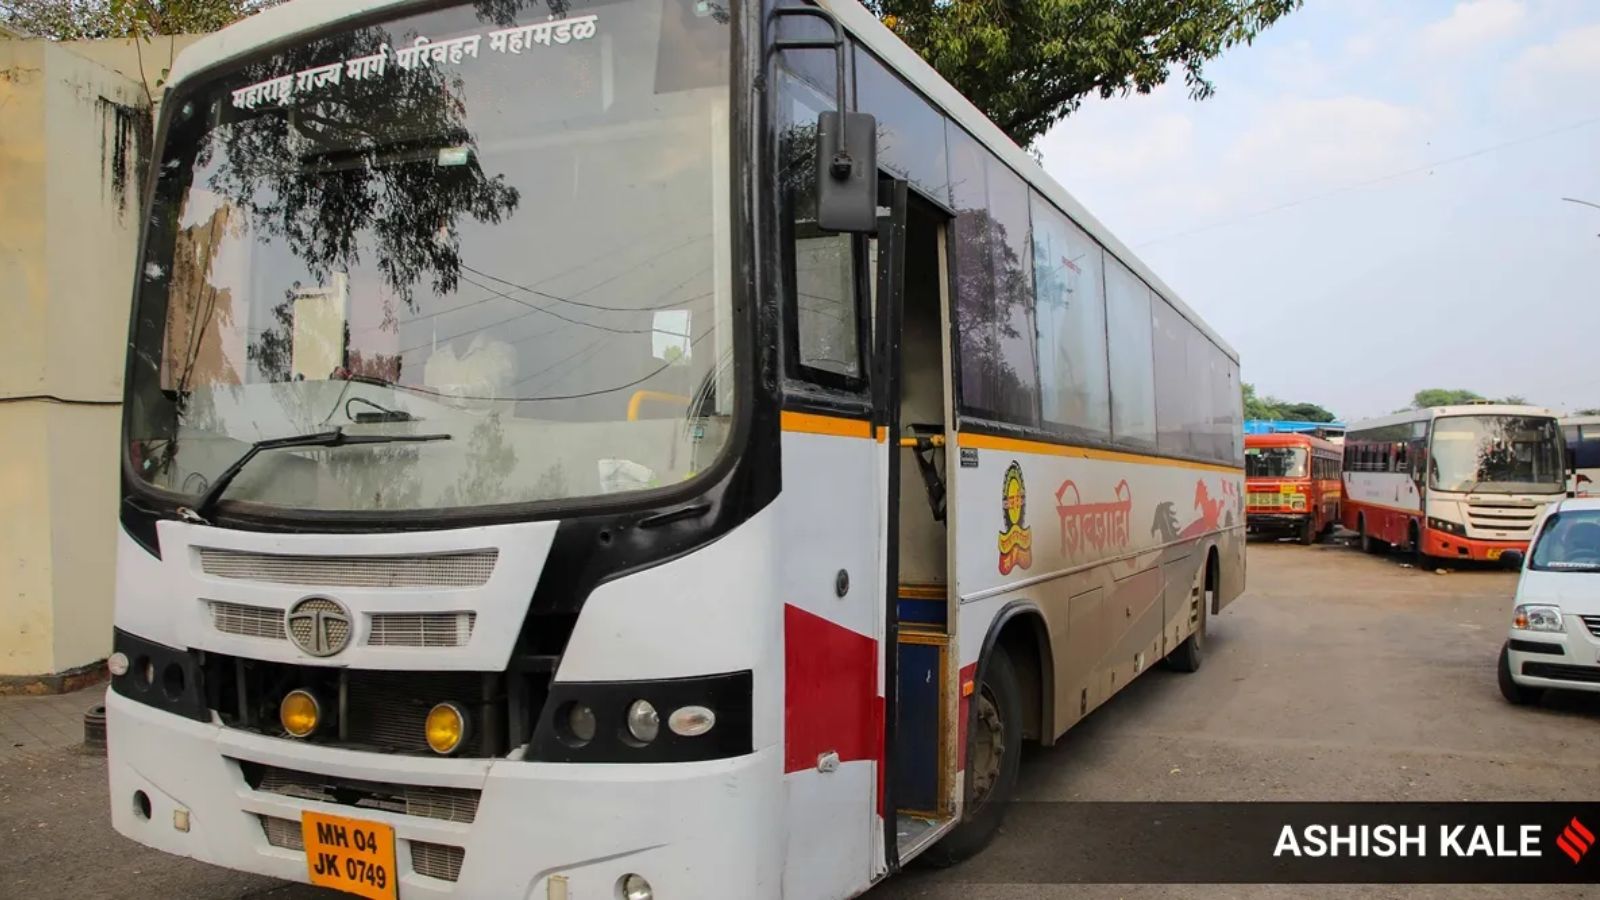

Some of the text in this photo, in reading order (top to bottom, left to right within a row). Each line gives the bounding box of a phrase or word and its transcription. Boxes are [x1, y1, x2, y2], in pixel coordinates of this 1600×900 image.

[231, 15, 598, 108] महाराष्ट्र राज्य मार्ग परिवहन महामंडळ
[317, 822, 377, 854] MH 04
[314, 852, 386, 889] JK 0749
